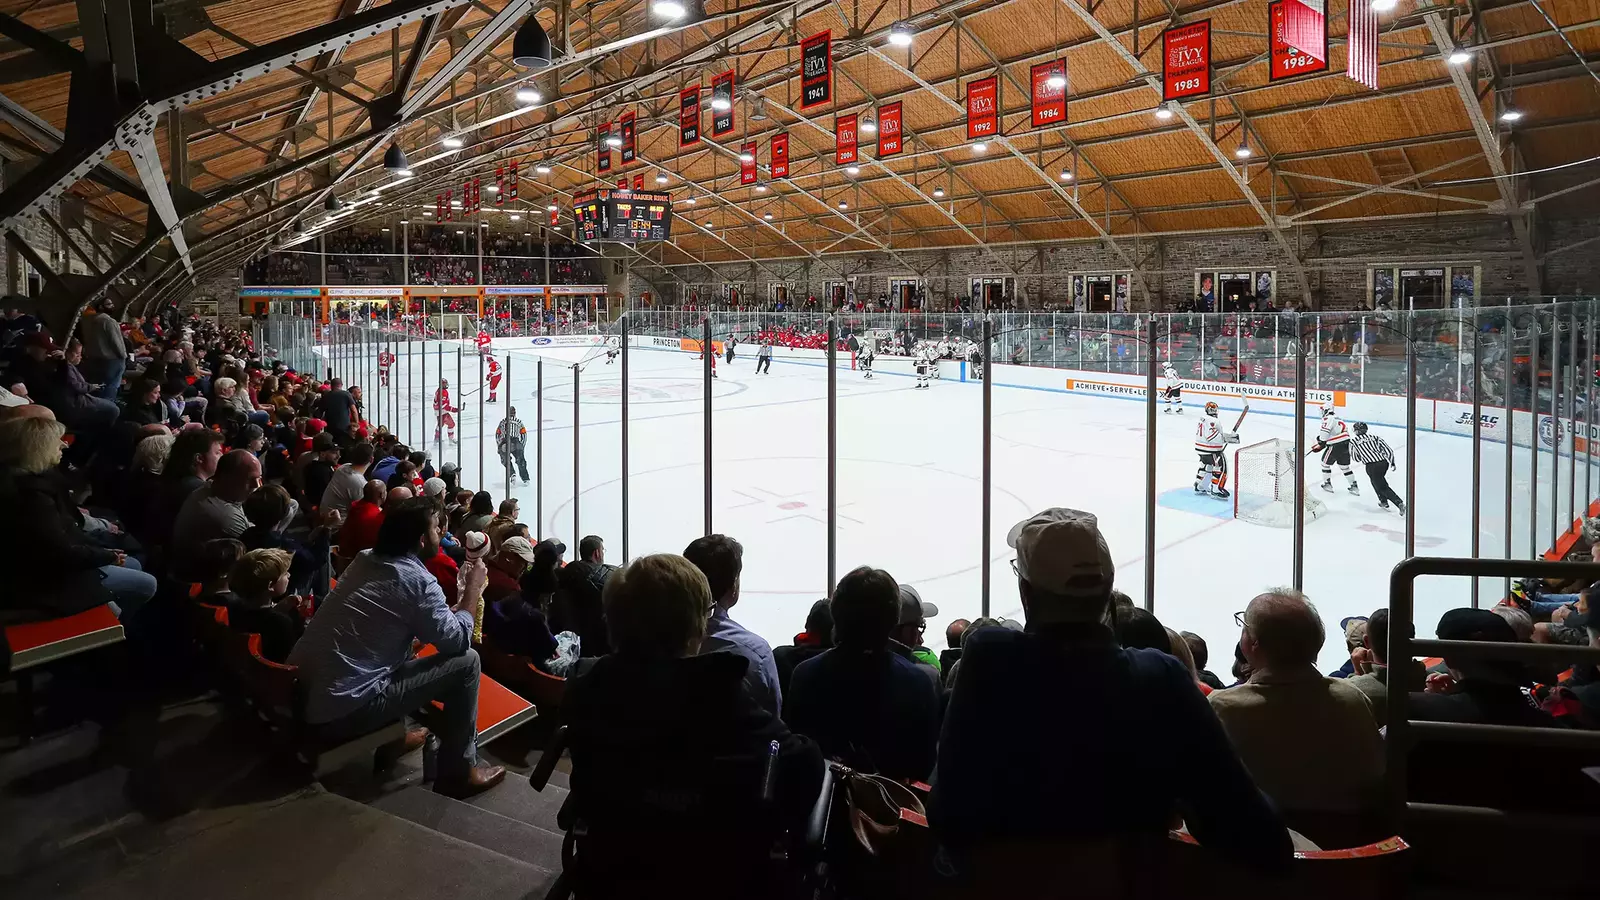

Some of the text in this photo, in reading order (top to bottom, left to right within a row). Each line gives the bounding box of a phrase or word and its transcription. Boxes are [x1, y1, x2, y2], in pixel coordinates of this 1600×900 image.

[1179, 46, 1204, 62] IVY
[810, 56, 826, 71] IVY
[1178, 57, 1205, 67] LEAGUE
[1283, 55, 1314, 69] 1982
[1174, 78, 1200, 91] 1983
[808, 86, 824, 100] 1941
[977, 97, 993, 109] IVY
[1039, 108, 1060, 119] 1984
[885, 119, 899, 130] IVY
[974, 122, 991, 132] 1992
[652, 337, 681, 348] PRINCETON
[1075, 383, 1107, 392] ACHIEVE
[1110, 386, 1134, 395] SERVE
[1184, 382, 1227, 392] DUCATION
[1231, 386, 1273, 396] THROUGH
